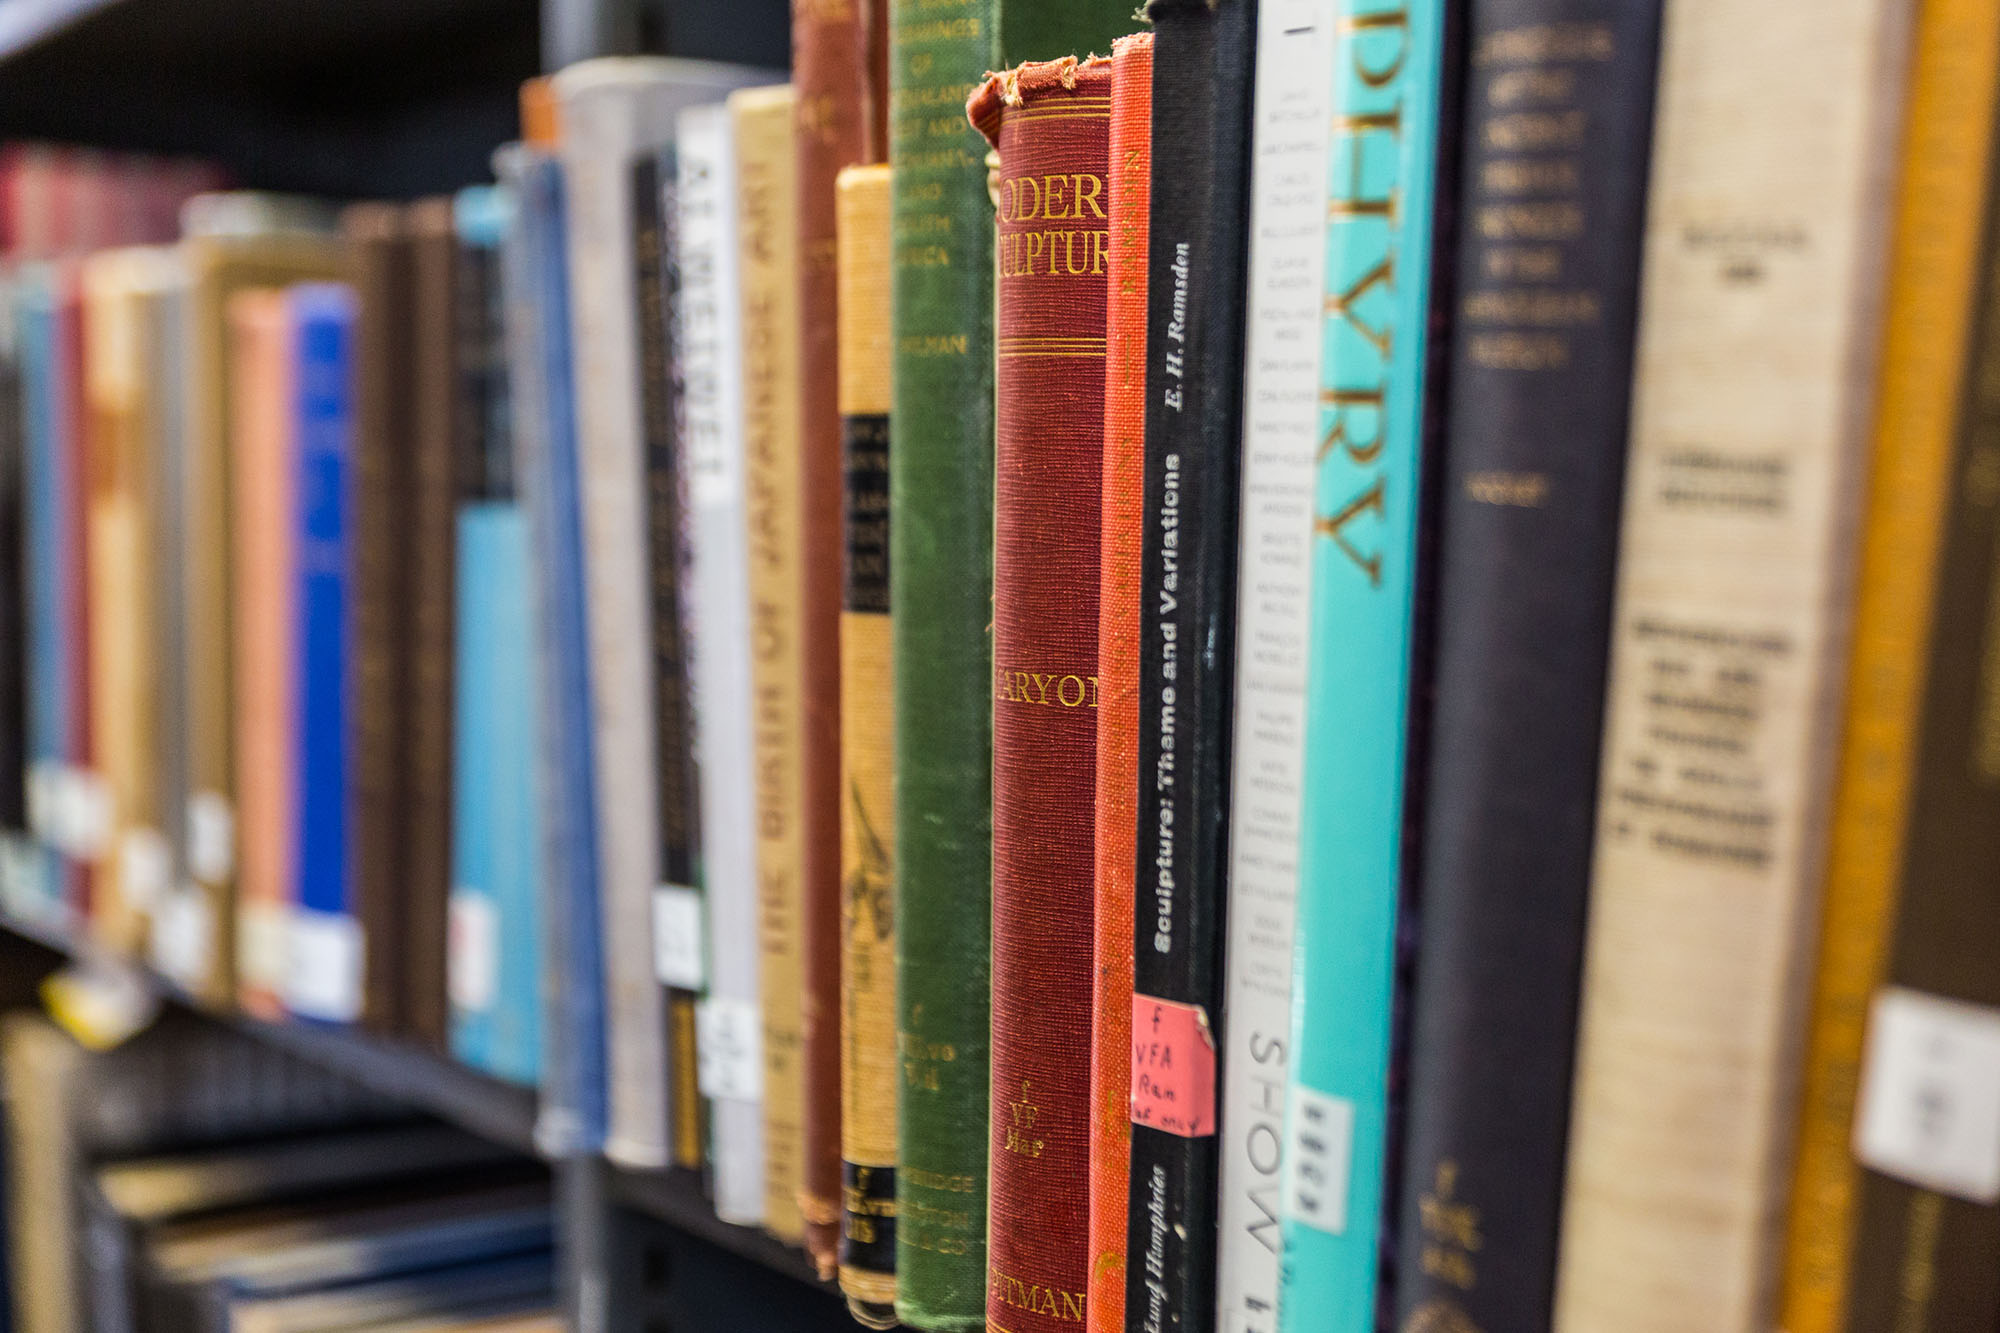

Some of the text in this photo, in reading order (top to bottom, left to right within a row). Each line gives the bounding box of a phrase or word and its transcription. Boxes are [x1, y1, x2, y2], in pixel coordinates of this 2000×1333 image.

[999, 229, 1109, 278] ULPTUR
[1000, 173, 1109, 223] ODER
[1164, 242, 1191, 413] E. H. Ramsden
[998, 669, 1098, 707] ARYO
[1153, 453, 1181, 954] Sculpture: Theme and Variations
[1246, 1030, 1287, 1255] SHOW
[1144, 1162, 1171, 1278] Humphries
